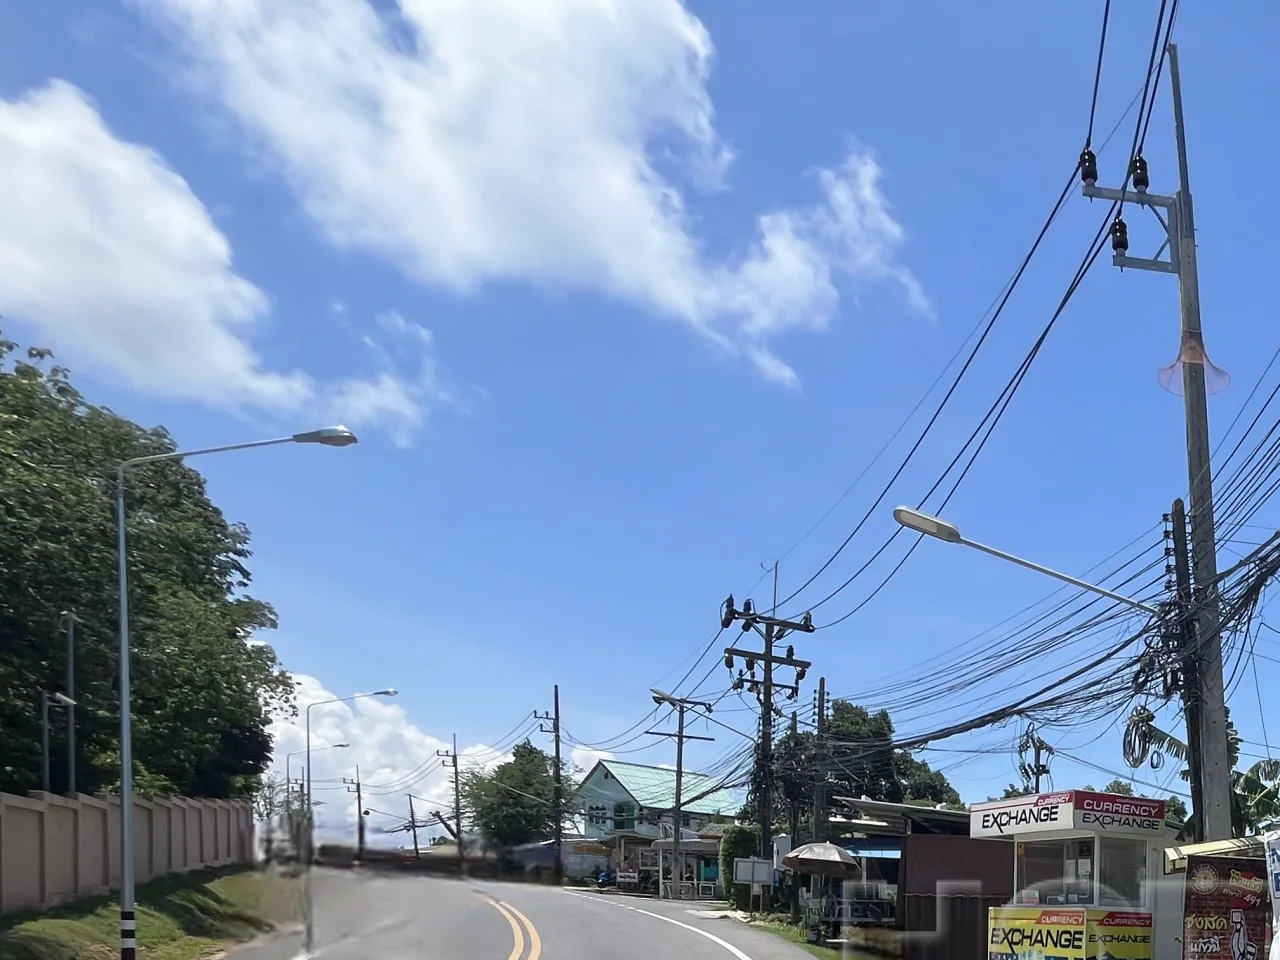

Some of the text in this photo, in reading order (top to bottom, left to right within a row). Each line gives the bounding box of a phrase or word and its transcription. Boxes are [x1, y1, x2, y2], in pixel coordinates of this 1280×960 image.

[1037, 796, 1070, 806] CURRENCY
[1083, 799, 1159, 817] CURRENCY
[981, 805, 1060, 833] EXCHANGE
[1082, 813, 1160, 830] EXCHANGE
[1041, 915, 1084, 925] CURRENCY
[1103, 917, 1152, 926] CURRENCY
[990, 927, 1084, 954] EXCHANGE
[1088, 933, 1152, 946] EXCHANGE
